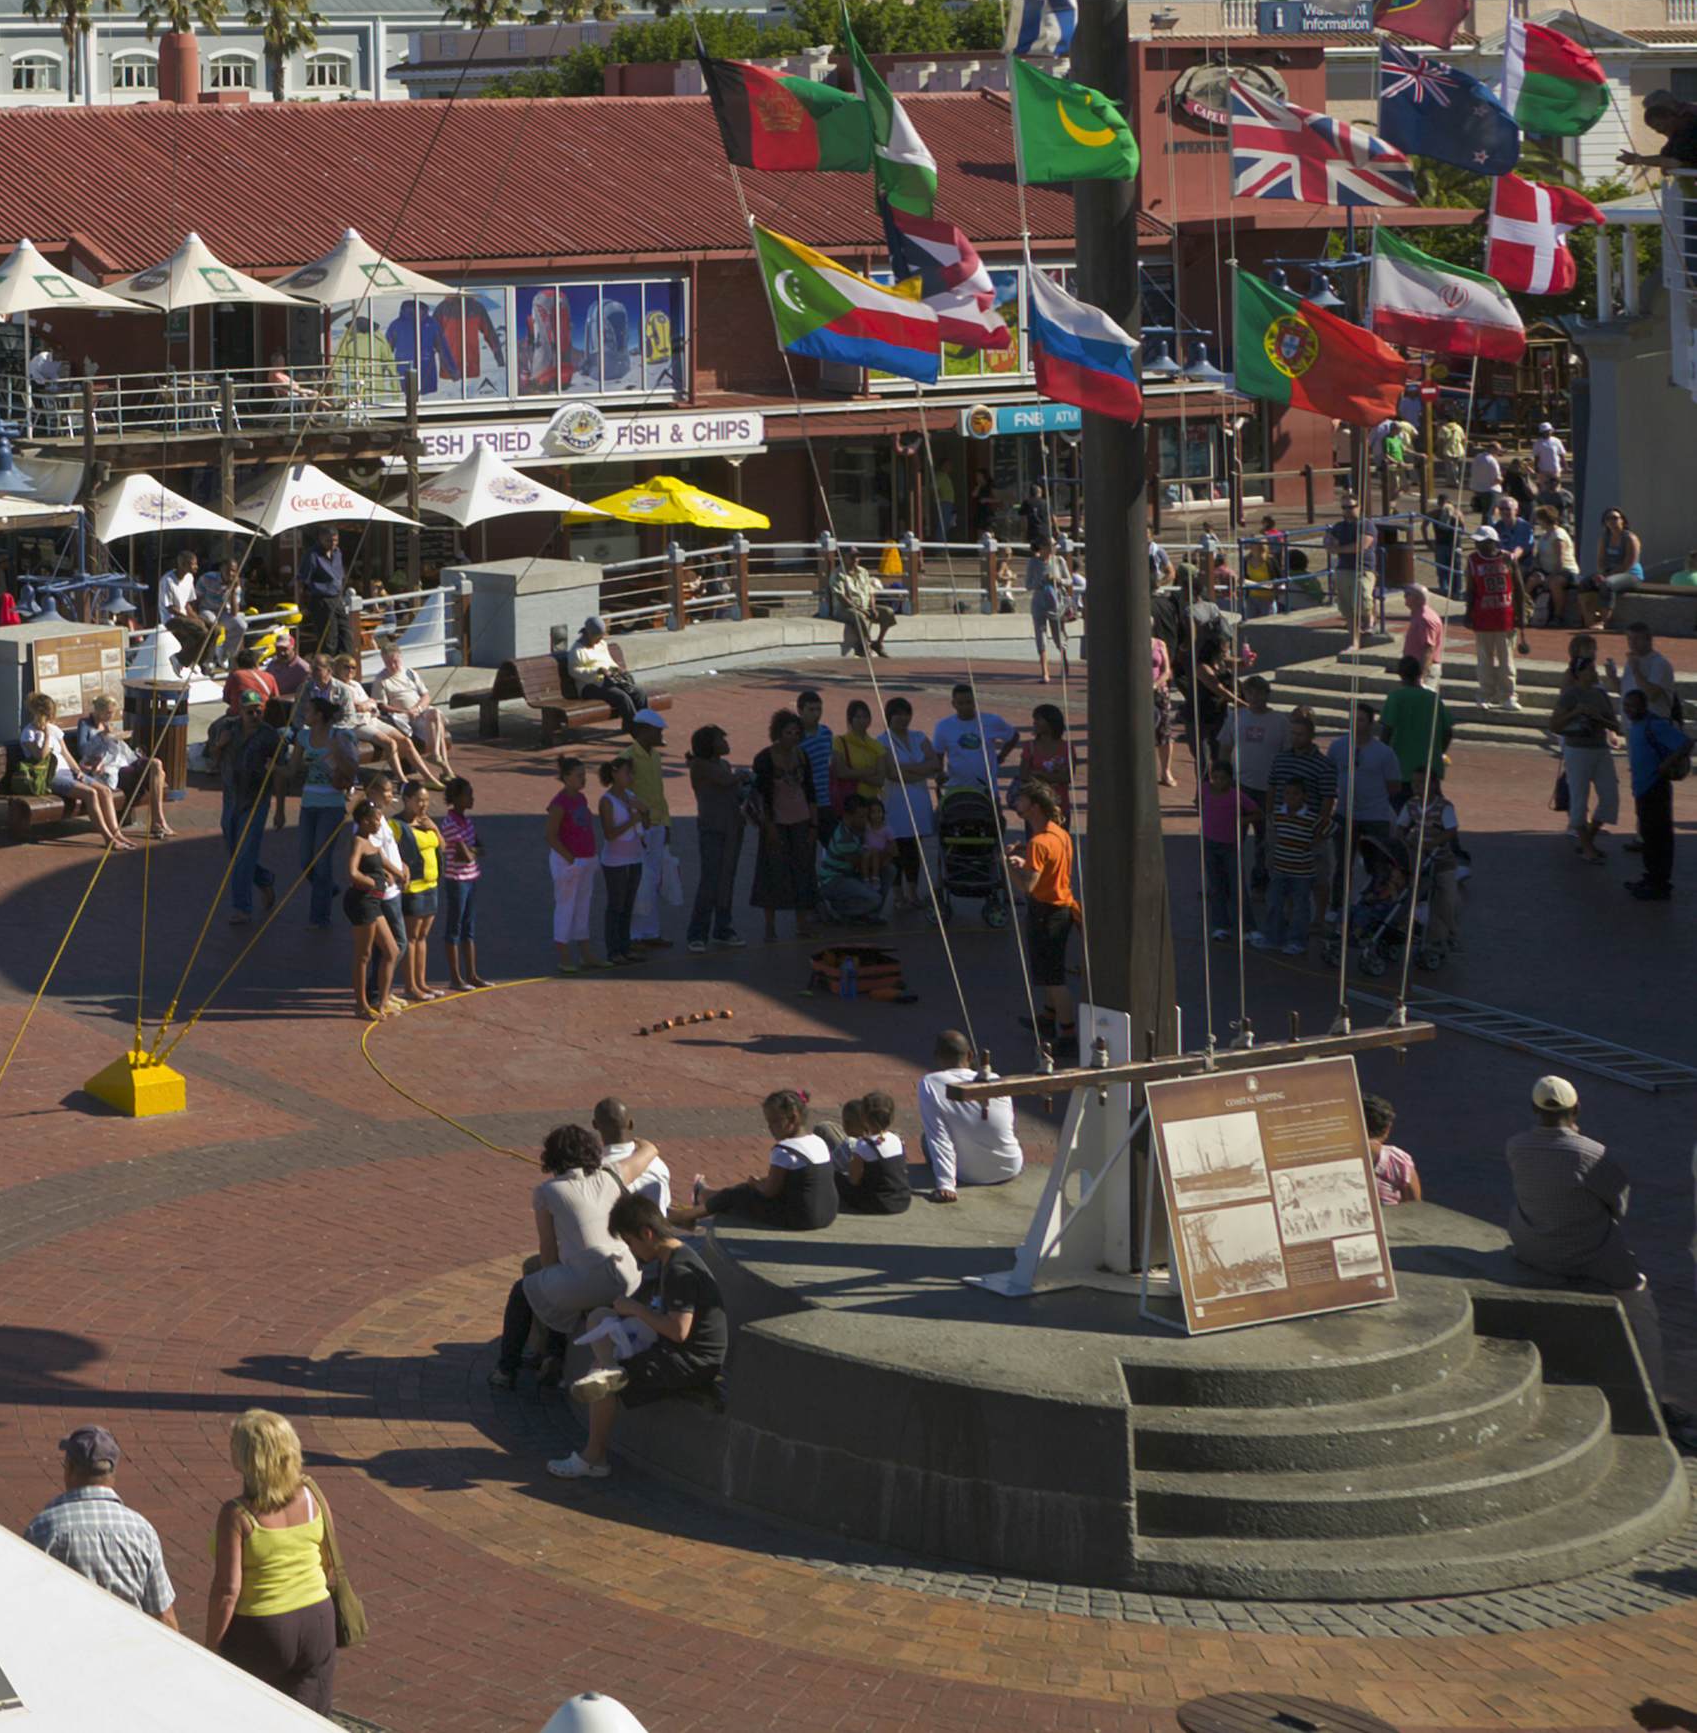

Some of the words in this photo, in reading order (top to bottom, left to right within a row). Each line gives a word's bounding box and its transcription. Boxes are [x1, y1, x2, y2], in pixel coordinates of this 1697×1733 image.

[1302, 18, 1370, 32] Information
[1014, 411, 1045, 427] FNB
[1055, 410, 1078, 424] ATM
[472, 432, 531, 454] FRIED
[617, 424, 661, 446] FISH
[670, 424, 684, 443] &
[691, 419, 751, 442] CHIPS
